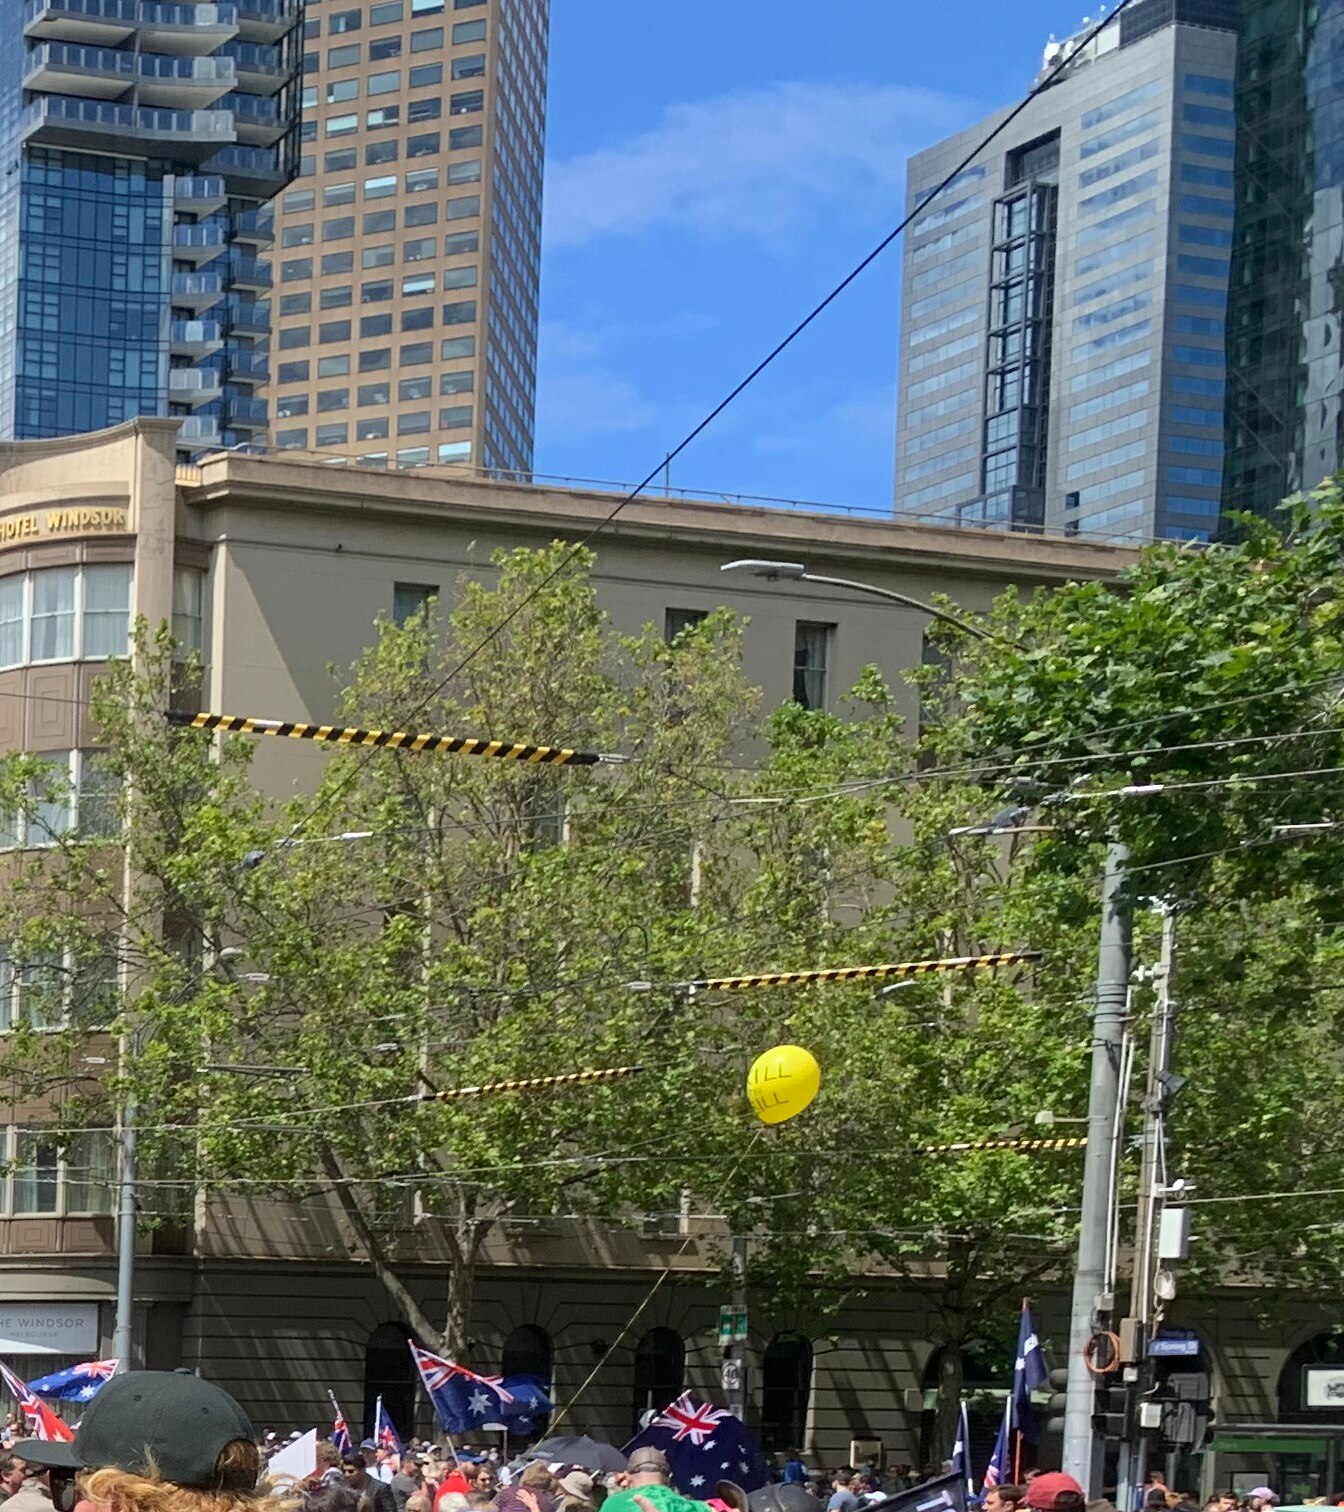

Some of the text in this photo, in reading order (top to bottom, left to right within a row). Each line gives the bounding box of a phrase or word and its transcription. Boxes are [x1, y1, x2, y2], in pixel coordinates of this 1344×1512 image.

[0, 509, 125, 541] HOTEL WINDSOR
[18, 1318, 85, 1328] WINDSOR
